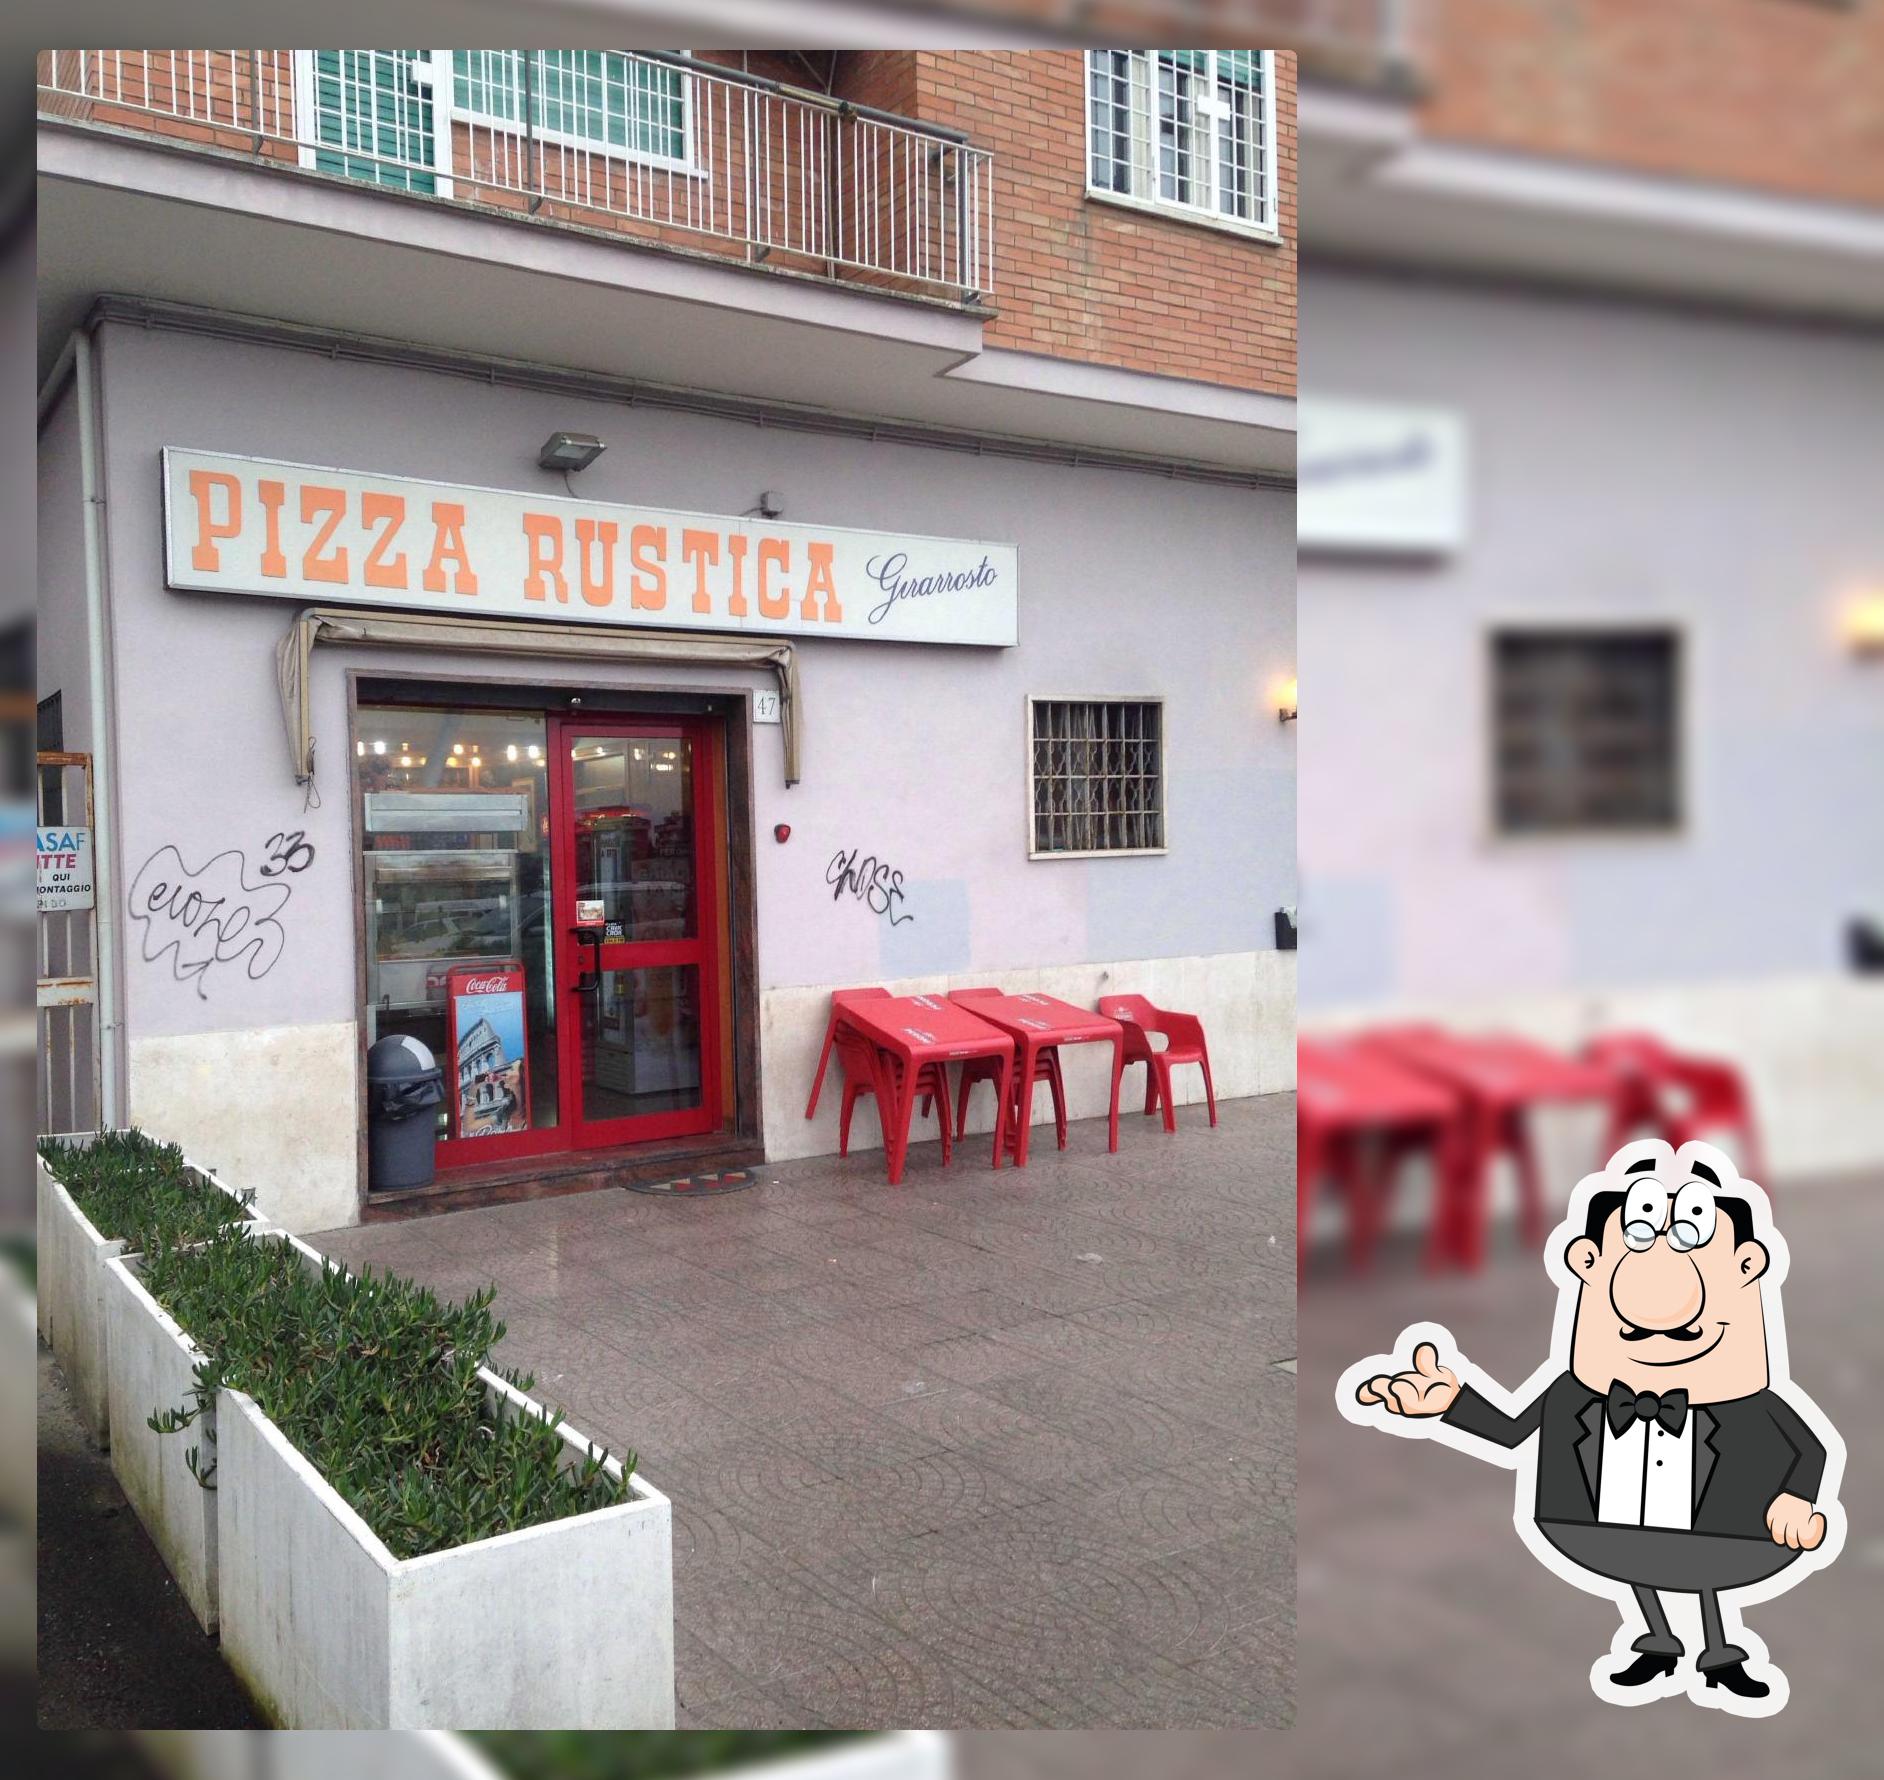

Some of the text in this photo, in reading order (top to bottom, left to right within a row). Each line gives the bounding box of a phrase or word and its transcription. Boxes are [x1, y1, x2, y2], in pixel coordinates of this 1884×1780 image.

[188, 469, 842, 624] PIZZA RUSTICA
[866, 553, 998, 625] Girarrosto
[757, 696, 776, 716] 47
[52, 873, 70, 882] QUI
[37, 884, 91, 894] ONTAGGIO
